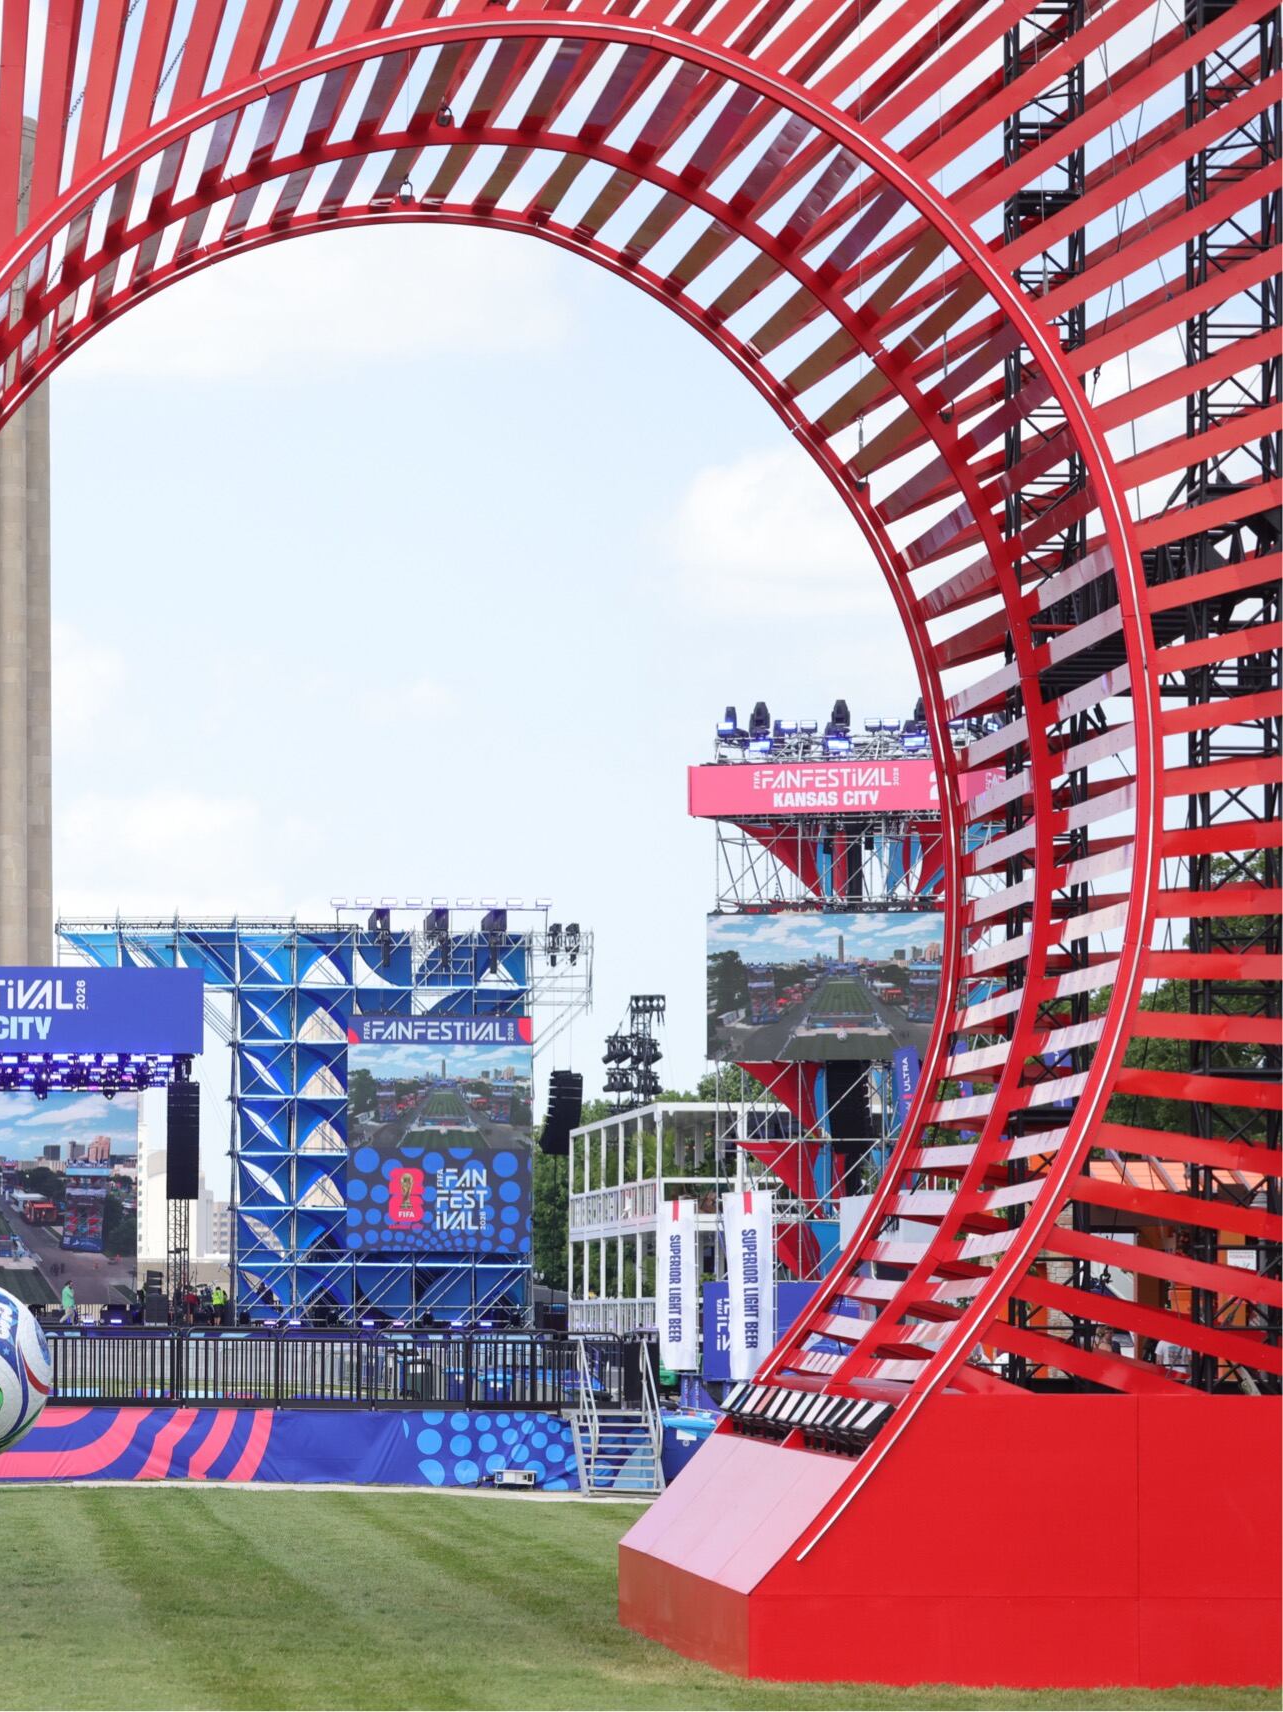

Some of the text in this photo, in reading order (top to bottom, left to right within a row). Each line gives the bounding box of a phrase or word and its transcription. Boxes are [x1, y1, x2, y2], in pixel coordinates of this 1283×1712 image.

[773, 790, 880, 807] KANSAS CITY
[76, 980, 87, 1010] 2026
[363, 1021, 371, 1040] FIFA
[902, 1057, 911, 1092] ULTRA
[436, 1168, 487, 1187] FIFA FAN
[436, 1189, 488, 1208] FEST
[668, 1234, 682, 1343] SUPERIOR LIGHT BEER
[741, 1228, 759, 1349] SUPERIOR LIGHT BEER
